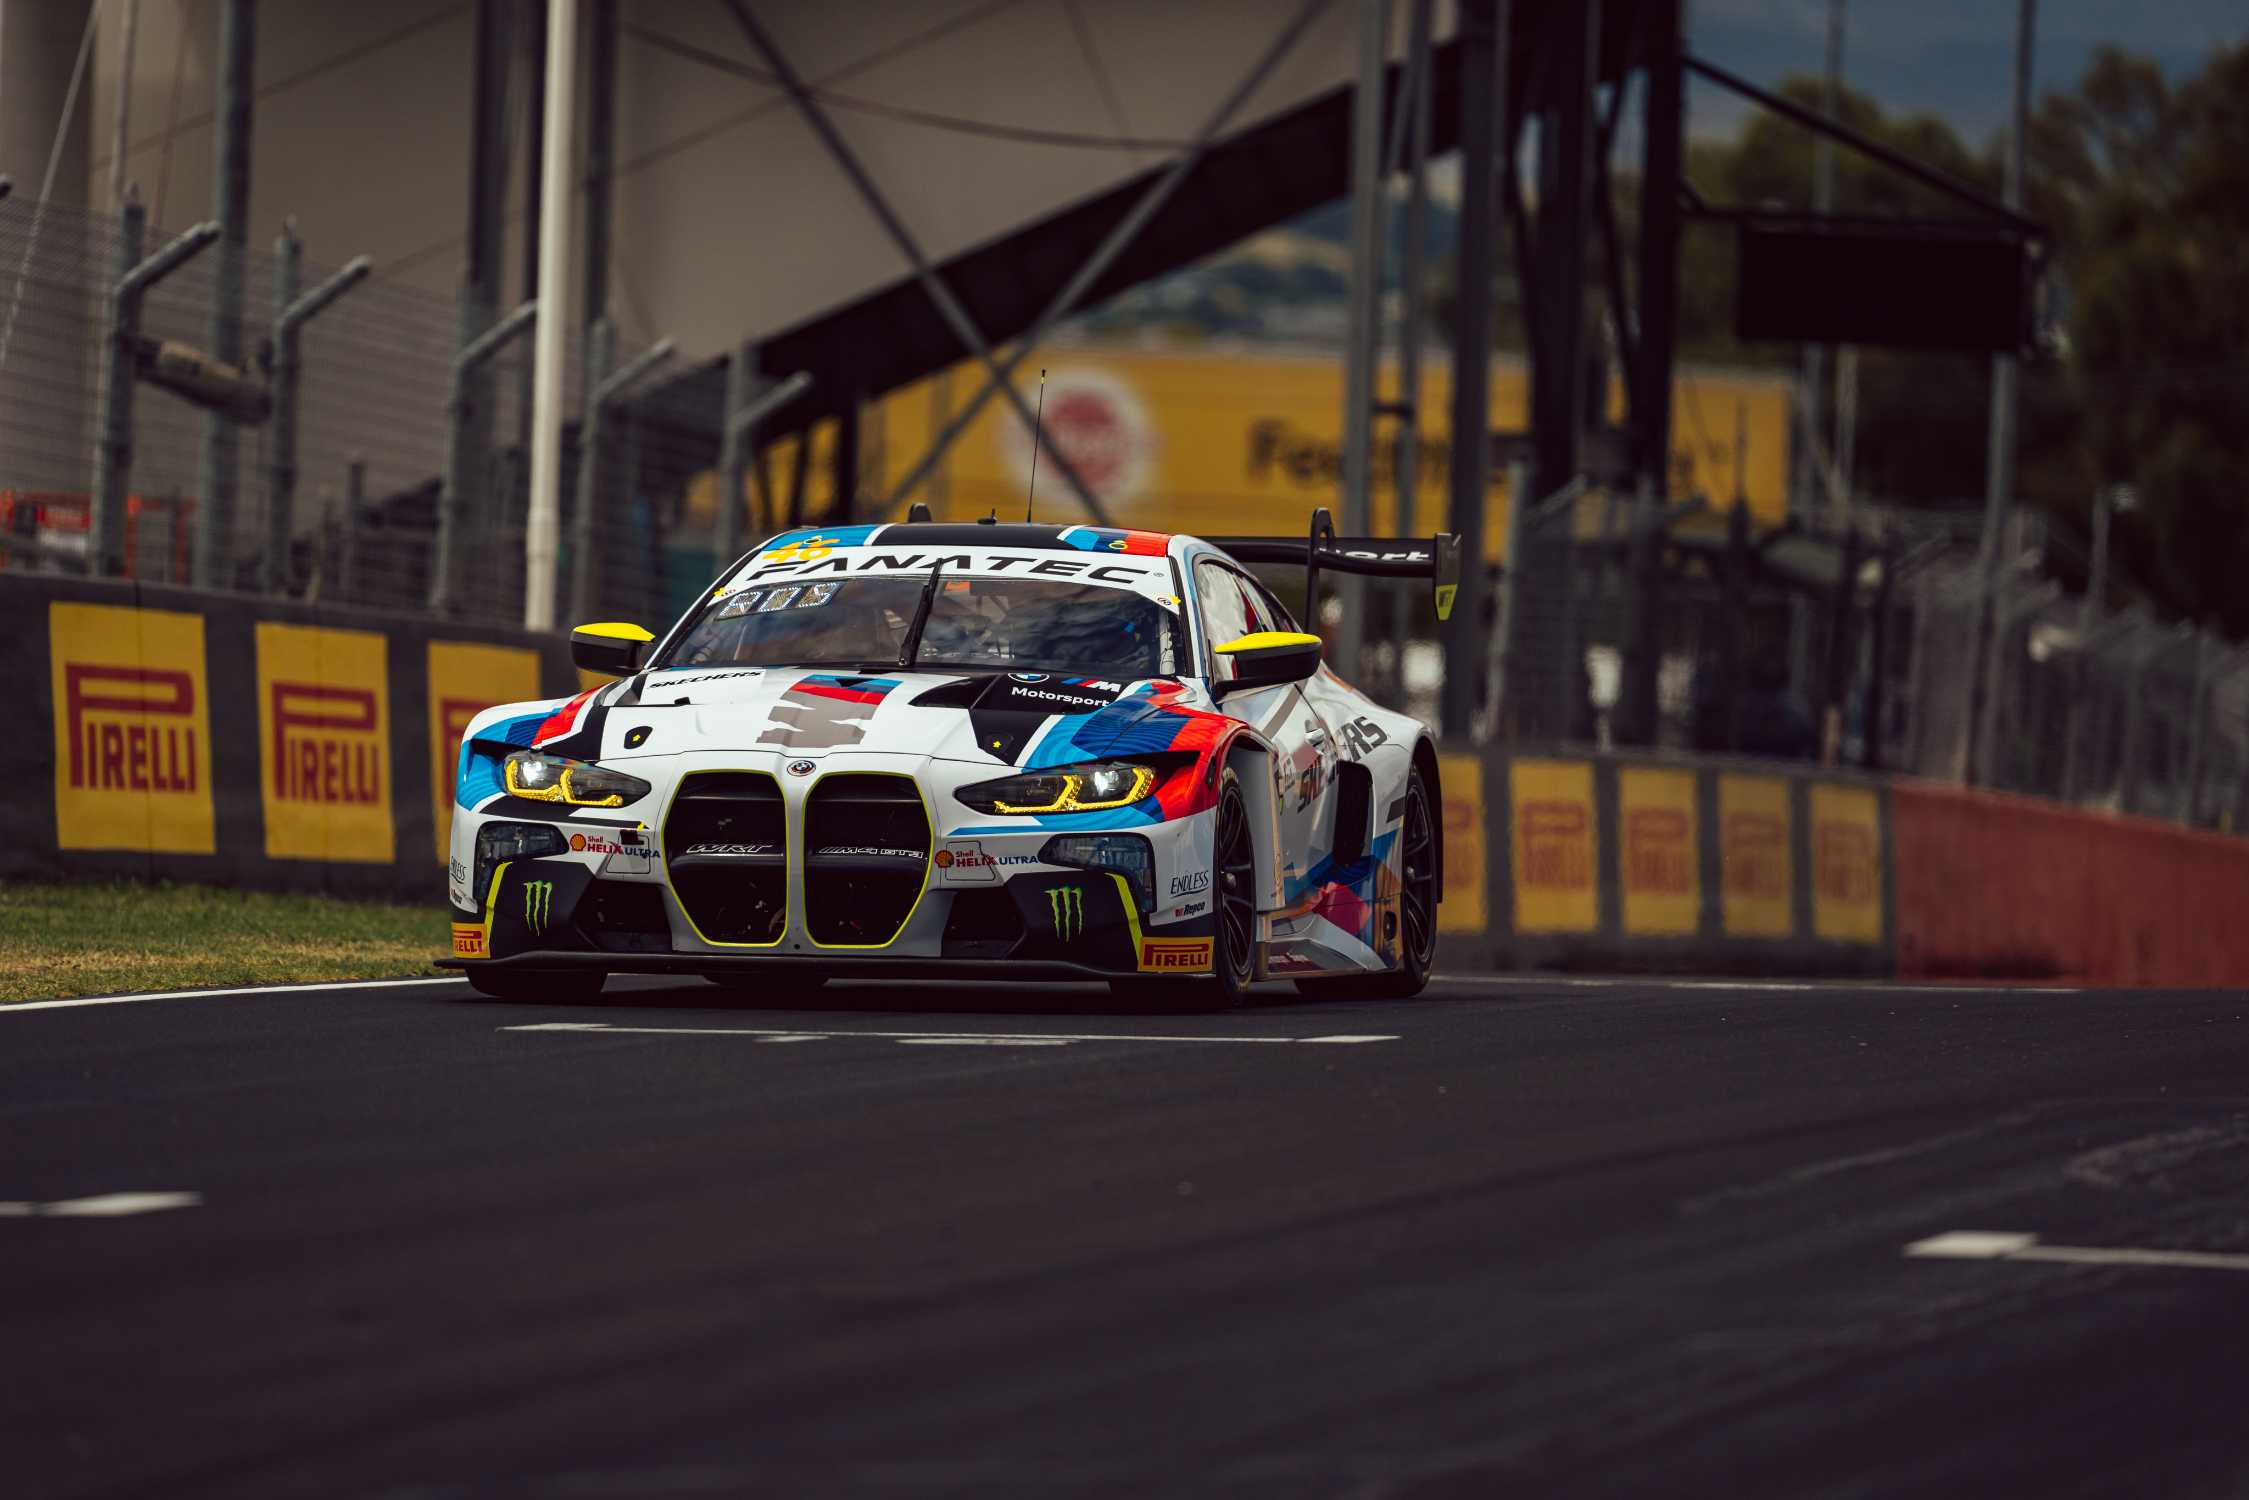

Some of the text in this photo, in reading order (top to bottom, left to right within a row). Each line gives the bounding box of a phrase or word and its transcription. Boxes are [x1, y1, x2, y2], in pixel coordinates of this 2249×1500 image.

[745, 554, 1149, 584] FANATEC
[649, 671, 763, 689] SKECHERS
[1011, 686, 1110, 707] Motorsport
[65, 662, 197, 794] PIRELLI
[271, 680, 381, 806] PIRELLI
[587, 842, 660, 858] HELIX ULTRA
[956, 854, 1039, 867] HELIX ULTRA
[1170, 870, 1209, 895] ENDLESS
[1184, 902, 1206, 916] Repco
[1143, 944, 1209, 966] PIRELLI
